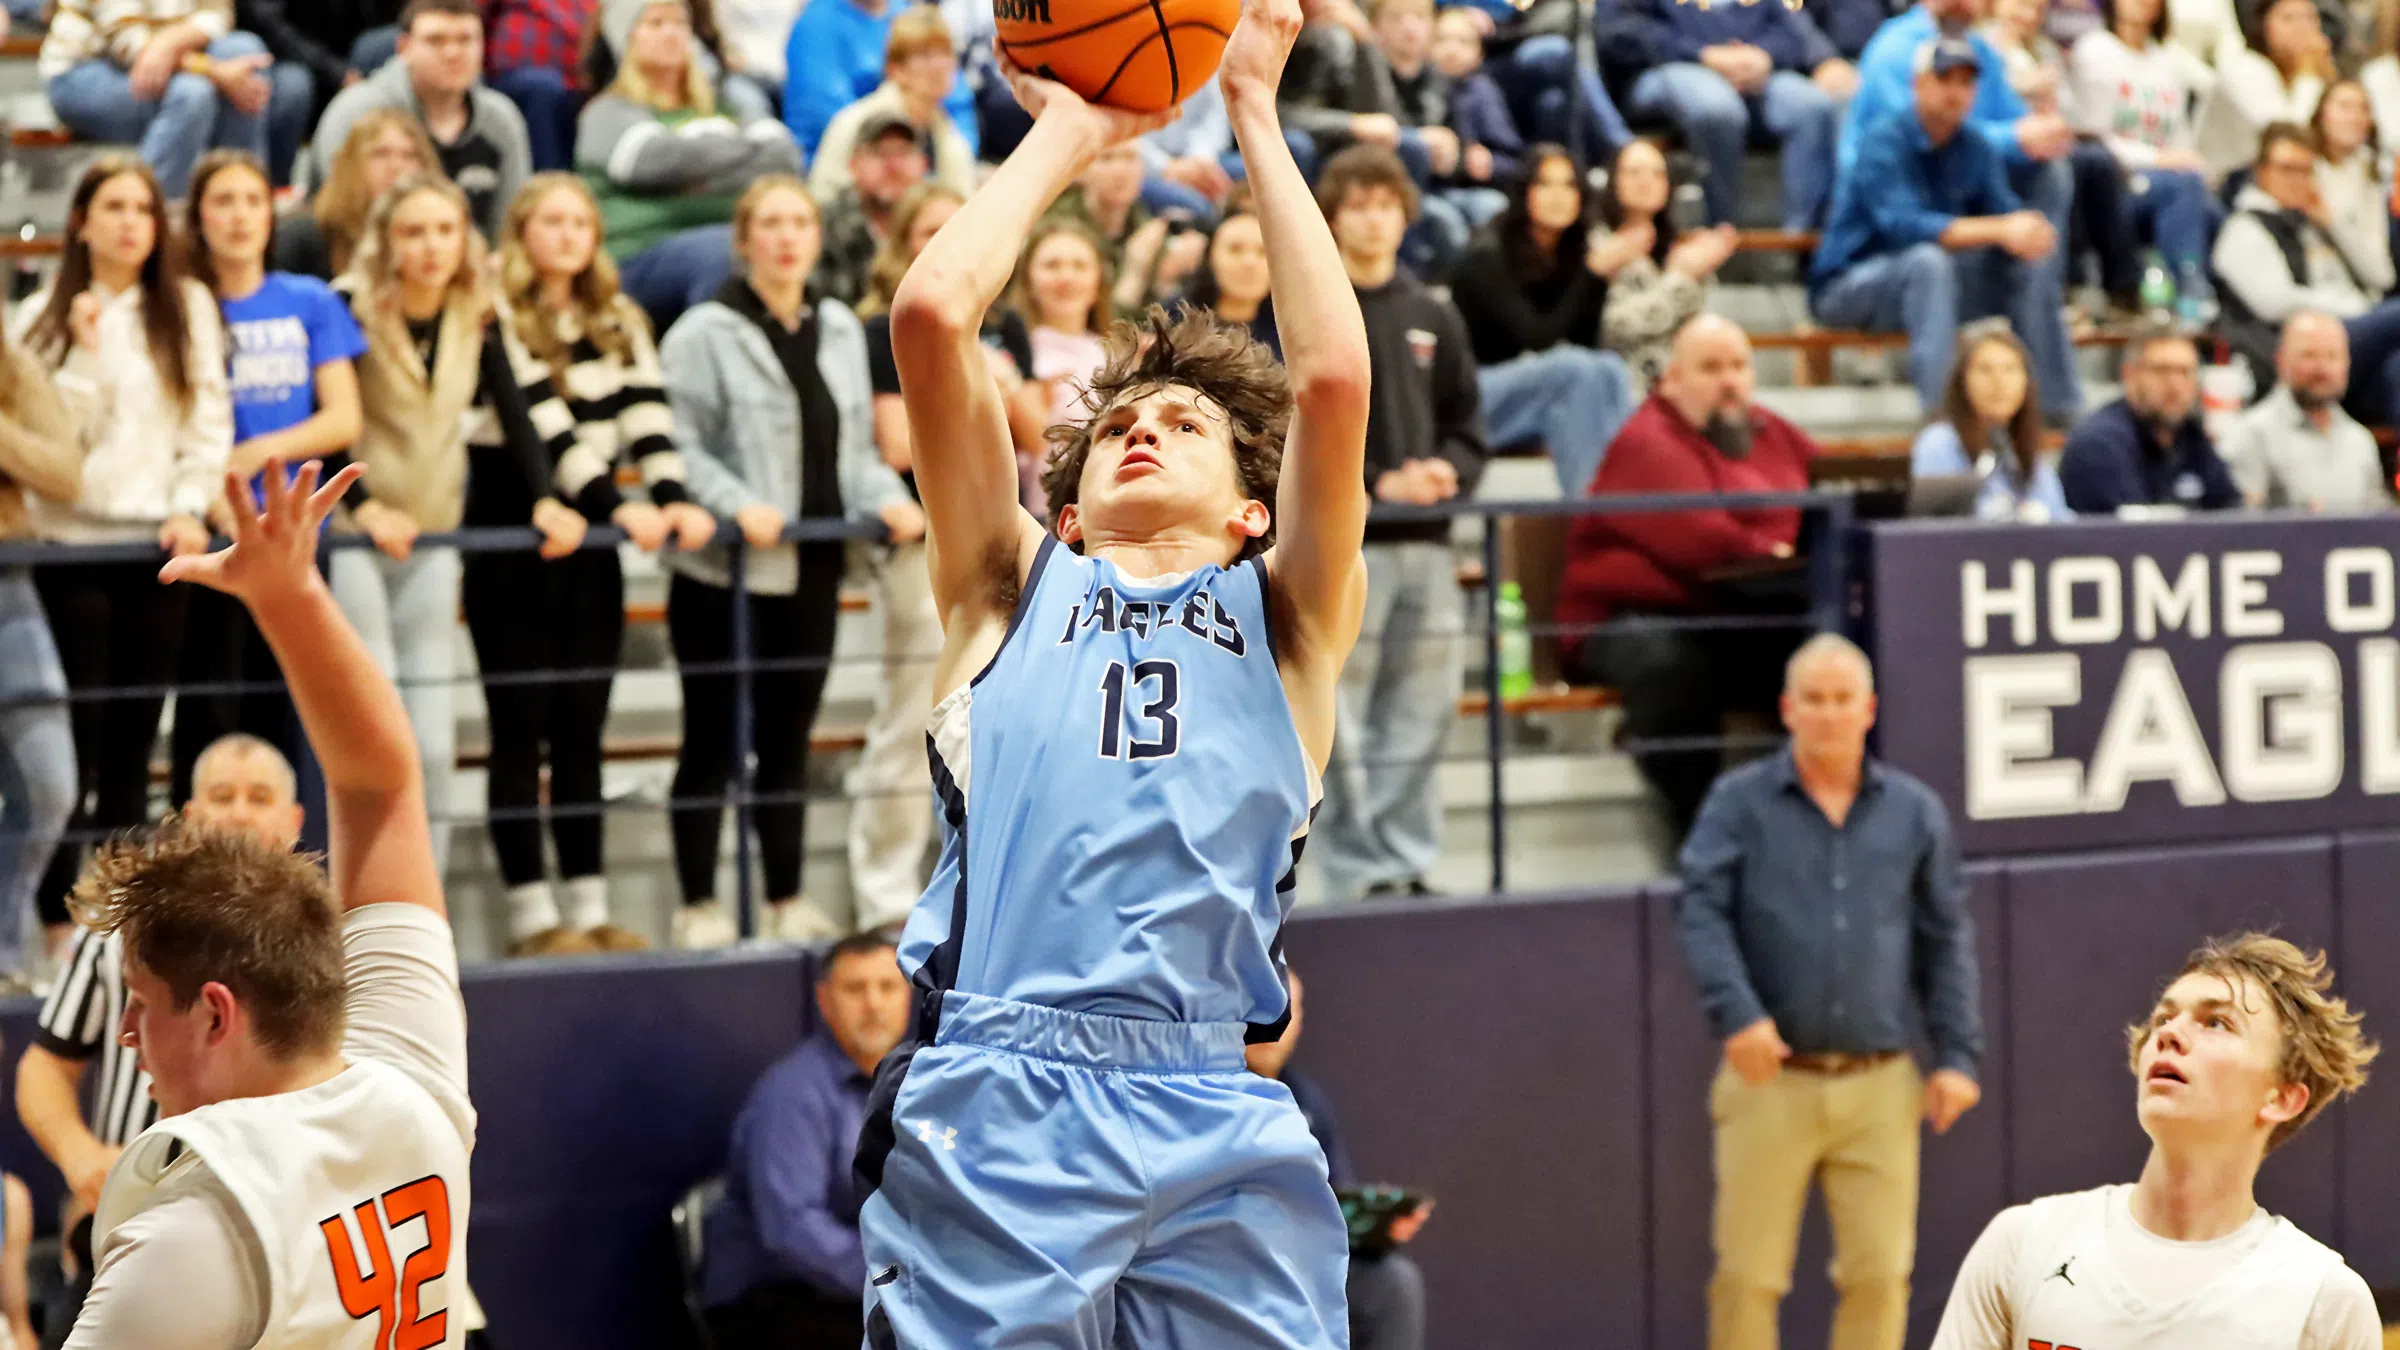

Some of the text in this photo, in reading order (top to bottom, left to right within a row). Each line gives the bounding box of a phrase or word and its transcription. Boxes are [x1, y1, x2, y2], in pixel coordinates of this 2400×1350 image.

[1961, 546, 2396, 647] HOME O
[1098, 659, 1180, 762] 13
[319, 1174, 451, 1350] 42
